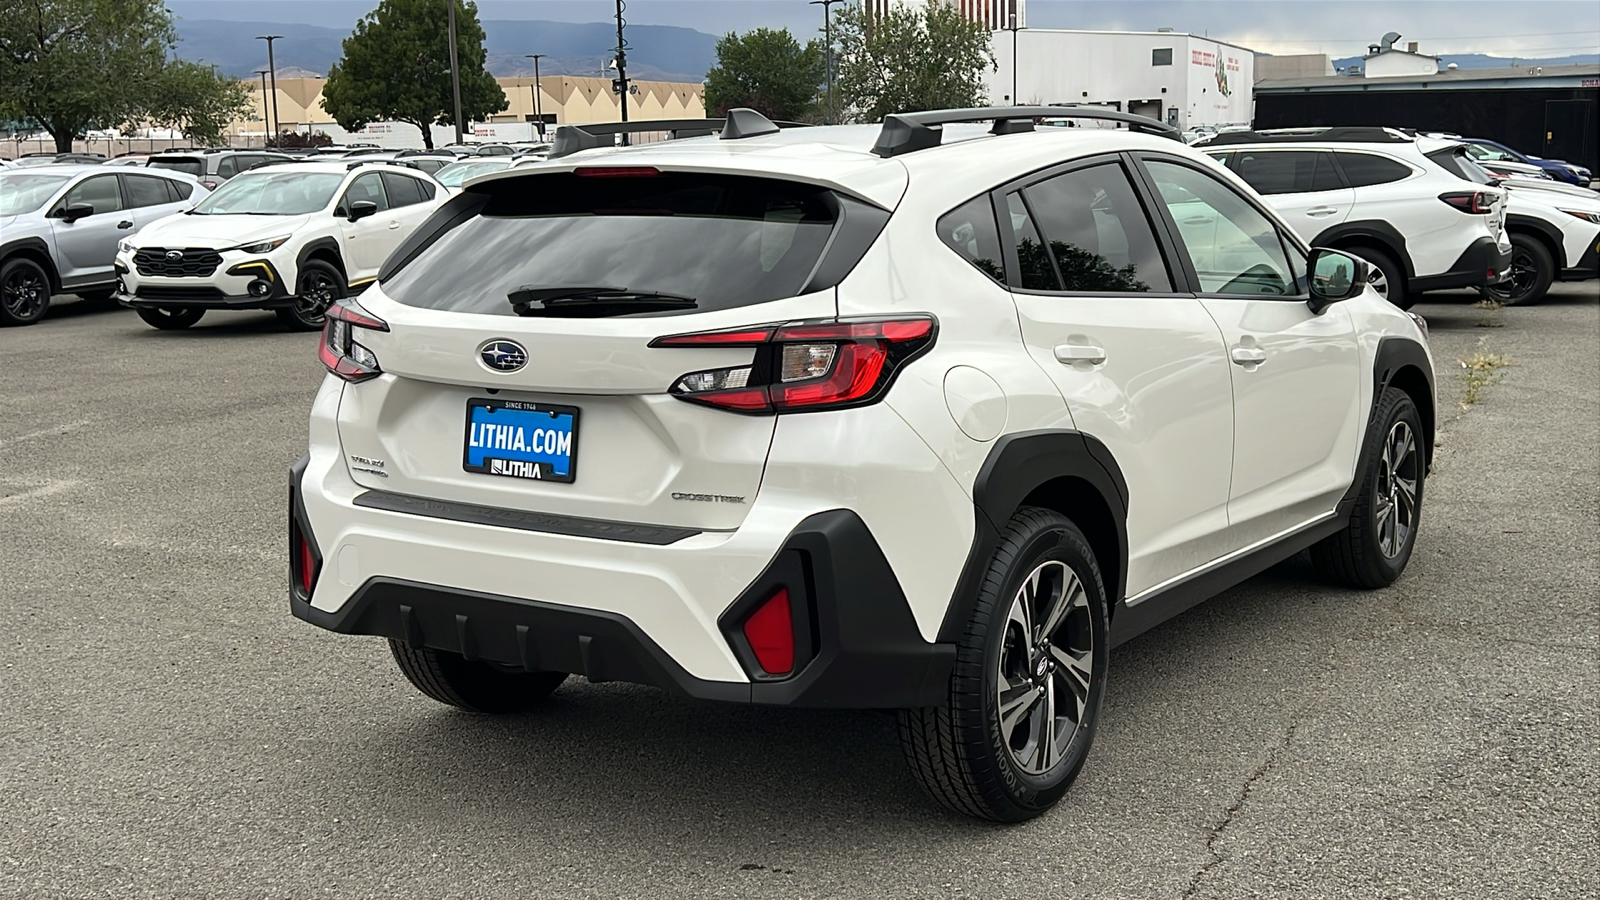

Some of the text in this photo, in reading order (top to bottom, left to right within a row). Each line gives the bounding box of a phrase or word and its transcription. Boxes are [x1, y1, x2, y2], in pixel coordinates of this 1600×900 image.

[505, 401, 537, 411] SINCE 1946
[469, 422, 572, 457] LITHIA.COM
[502, 460, 542, 479] LITHIA
[671, 492, 747, 504] CROSSTREK
[988, 708, 1018, 791] YOKOHAMA
